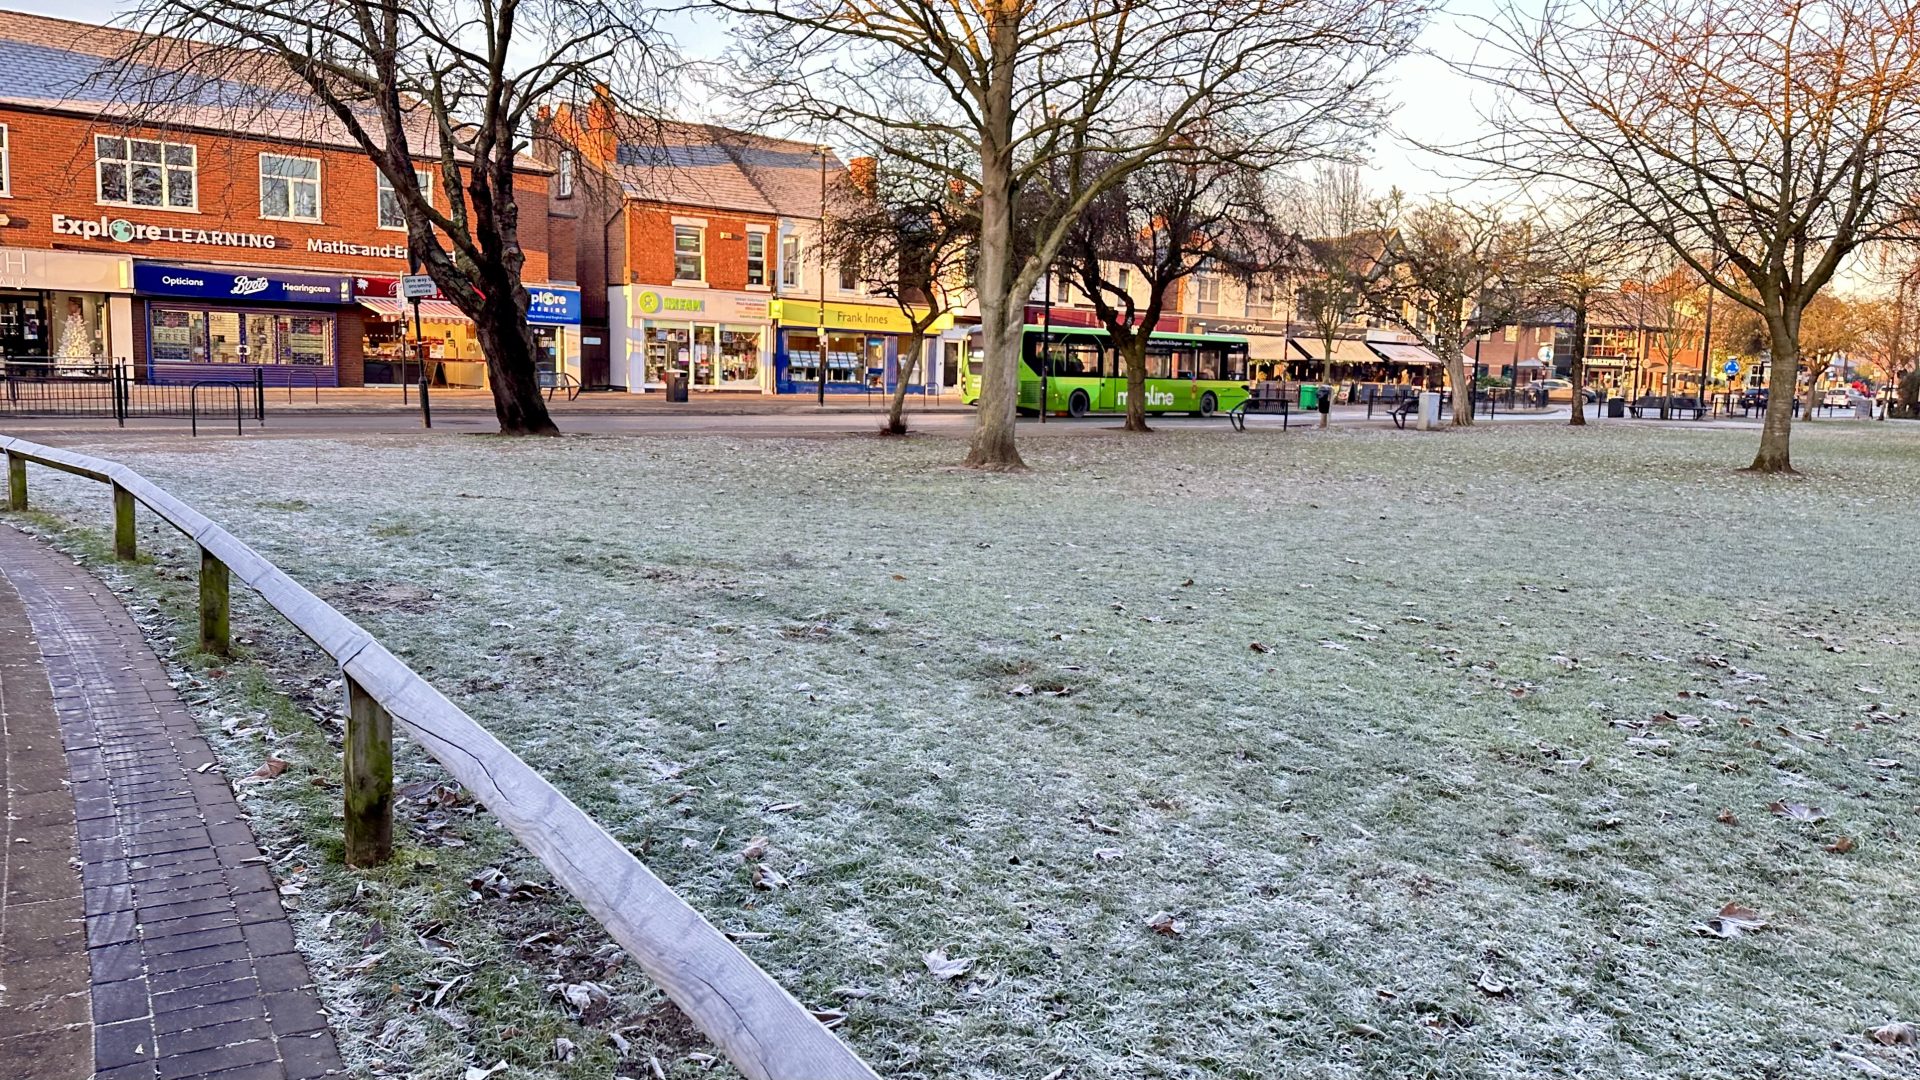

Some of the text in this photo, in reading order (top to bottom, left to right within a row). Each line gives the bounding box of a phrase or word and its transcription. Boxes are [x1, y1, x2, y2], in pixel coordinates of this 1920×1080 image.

[52, 214, 276, 249] Explore LEARNING
[307, 238, 358, 255] Maths
[361, 244, 391, 258] and
[162, 276, 204, 287] Opticians
[230, 275, 269, 295] Boots
[282, 282, 331, 294] Hearingcare
[531, 292, 566, 305] plore
[663, 296, 701, 312] OXFAM
[837, 311, 888, 325] Frank Innes
[158, 333, 187, 342] FREE
[1117, 384, 1184, 406] mnline
